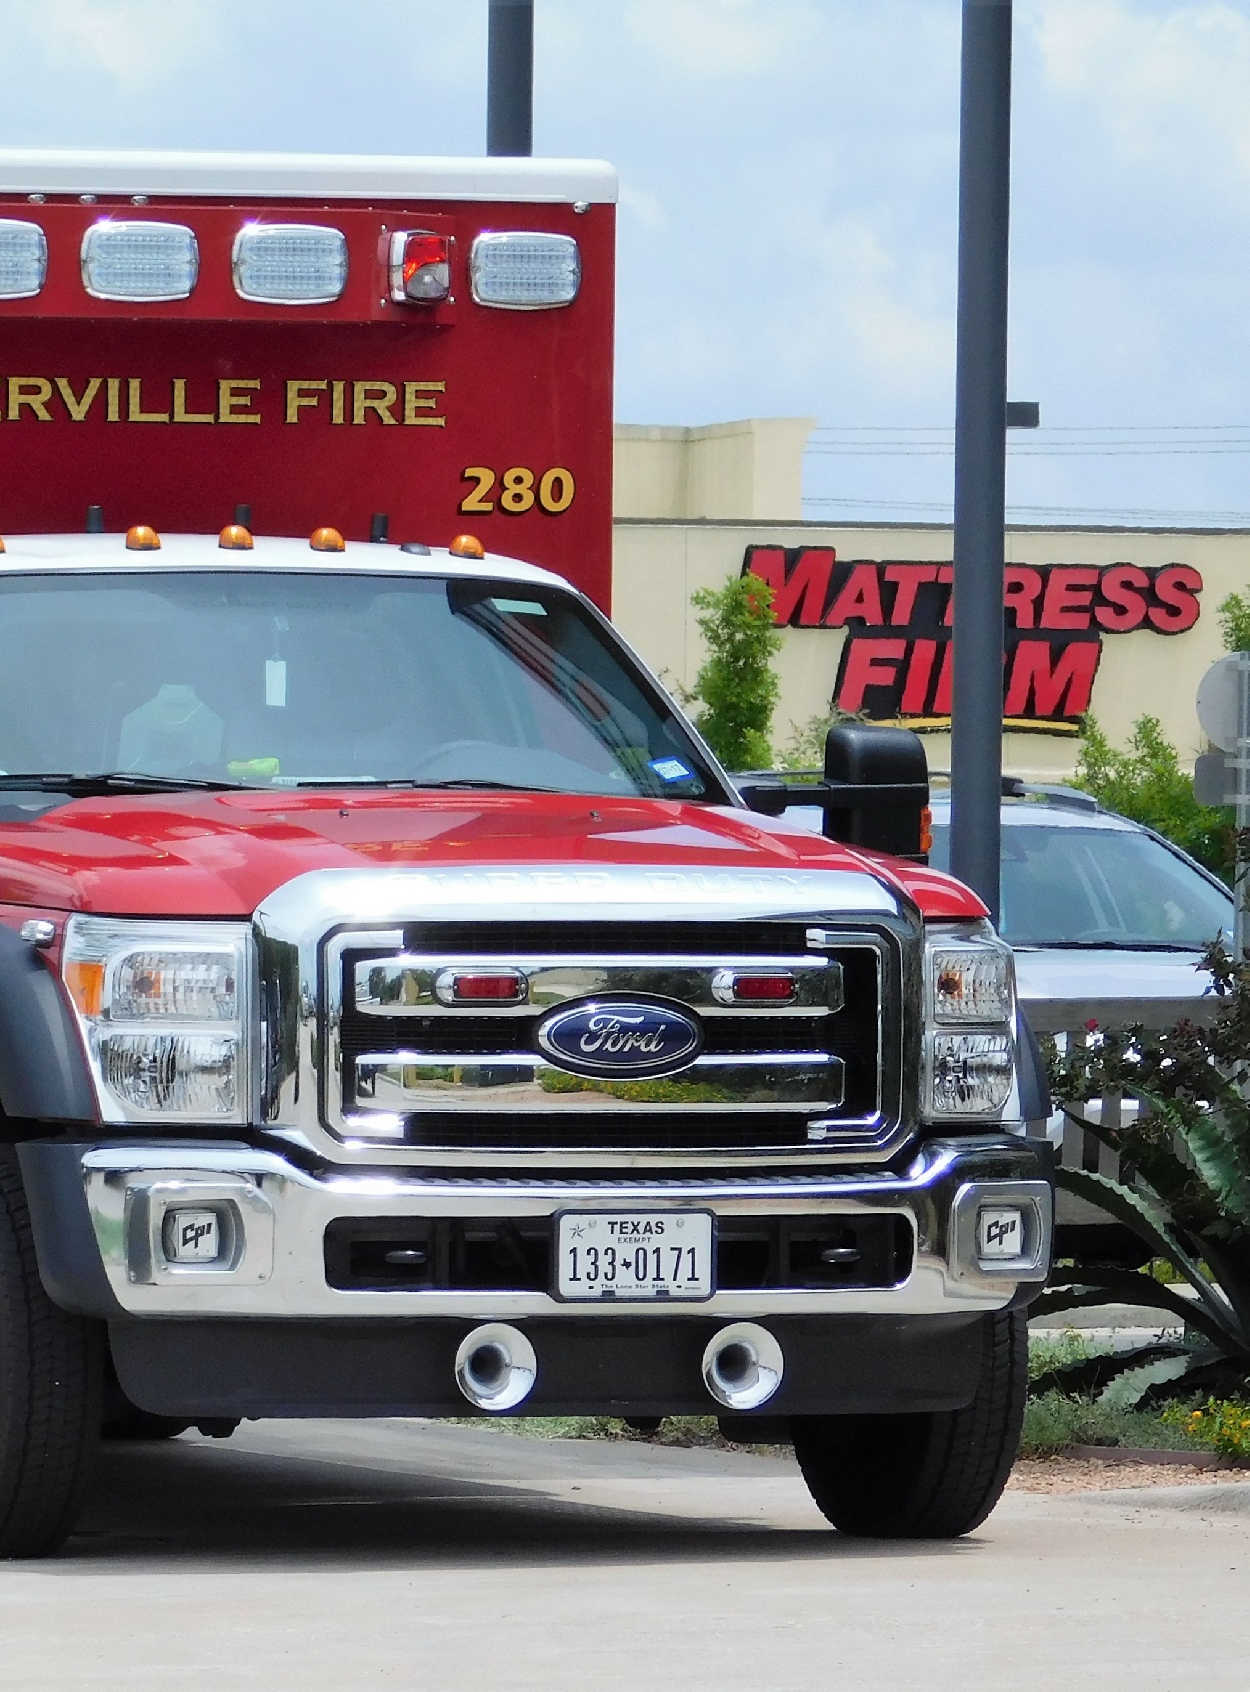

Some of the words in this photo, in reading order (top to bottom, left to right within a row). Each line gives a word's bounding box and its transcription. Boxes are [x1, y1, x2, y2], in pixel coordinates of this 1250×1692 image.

[284, 377, 447, 428] FIRE
[459, 466, 575, 516] 280
[645, 871, 813, 895] DUTY
[579, 1014, 667, 1053] Ford
[607, 1220, 666, 1236] TEXAS
[617, 1236, 652, 1244] EXEMPT
